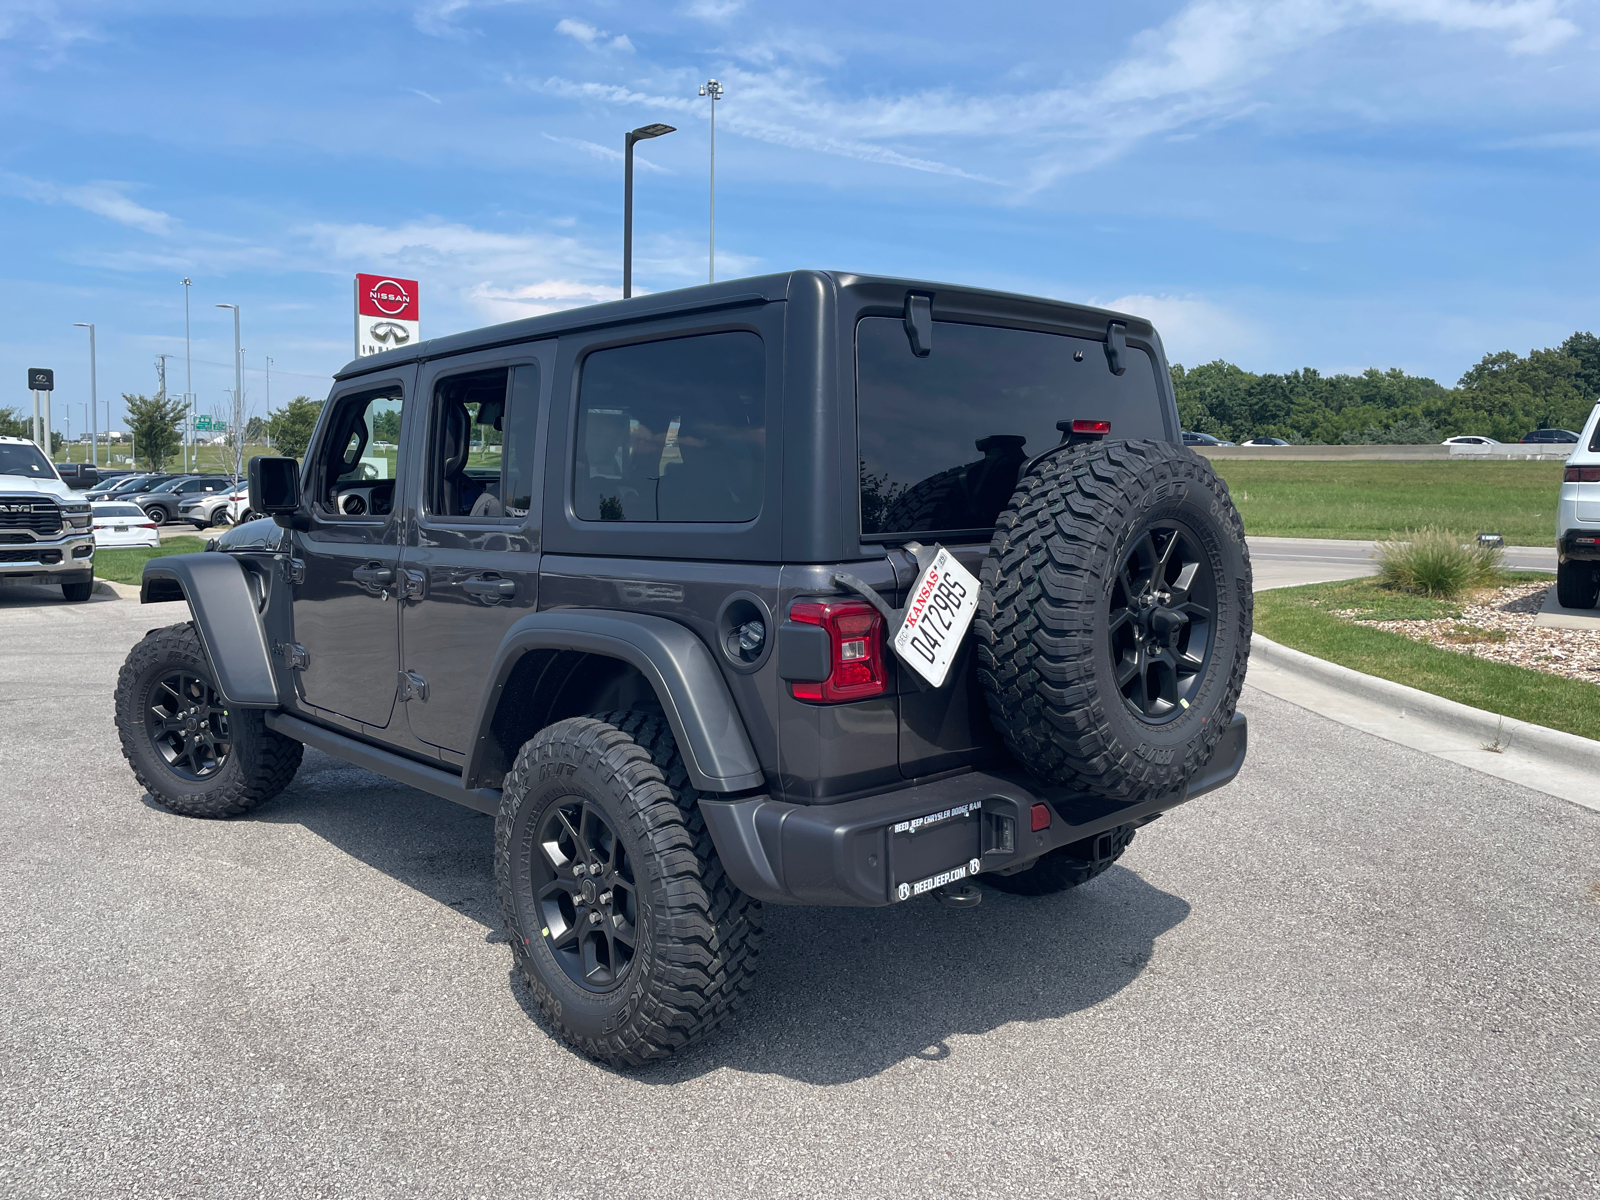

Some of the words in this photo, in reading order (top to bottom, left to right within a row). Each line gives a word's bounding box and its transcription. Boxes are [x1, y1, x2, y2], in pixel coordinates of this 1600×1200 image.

[370, 291, 410, 303] NISSAN
[906, 570, 939, 628] KANSAS
[910, 572, 967, 665] D4729BS
[897, 631, 908, 648] DEC
[894, 821, 909, 833] REED
[910, 818, 923, 829] JEEP
[924, 810, 951, 825] CHRYSLER
[951, 804, 969, 817] DODGE
[968, 800, 982, 812] RAM
[913, 866, 966, 895] REEDJEEP.COM
